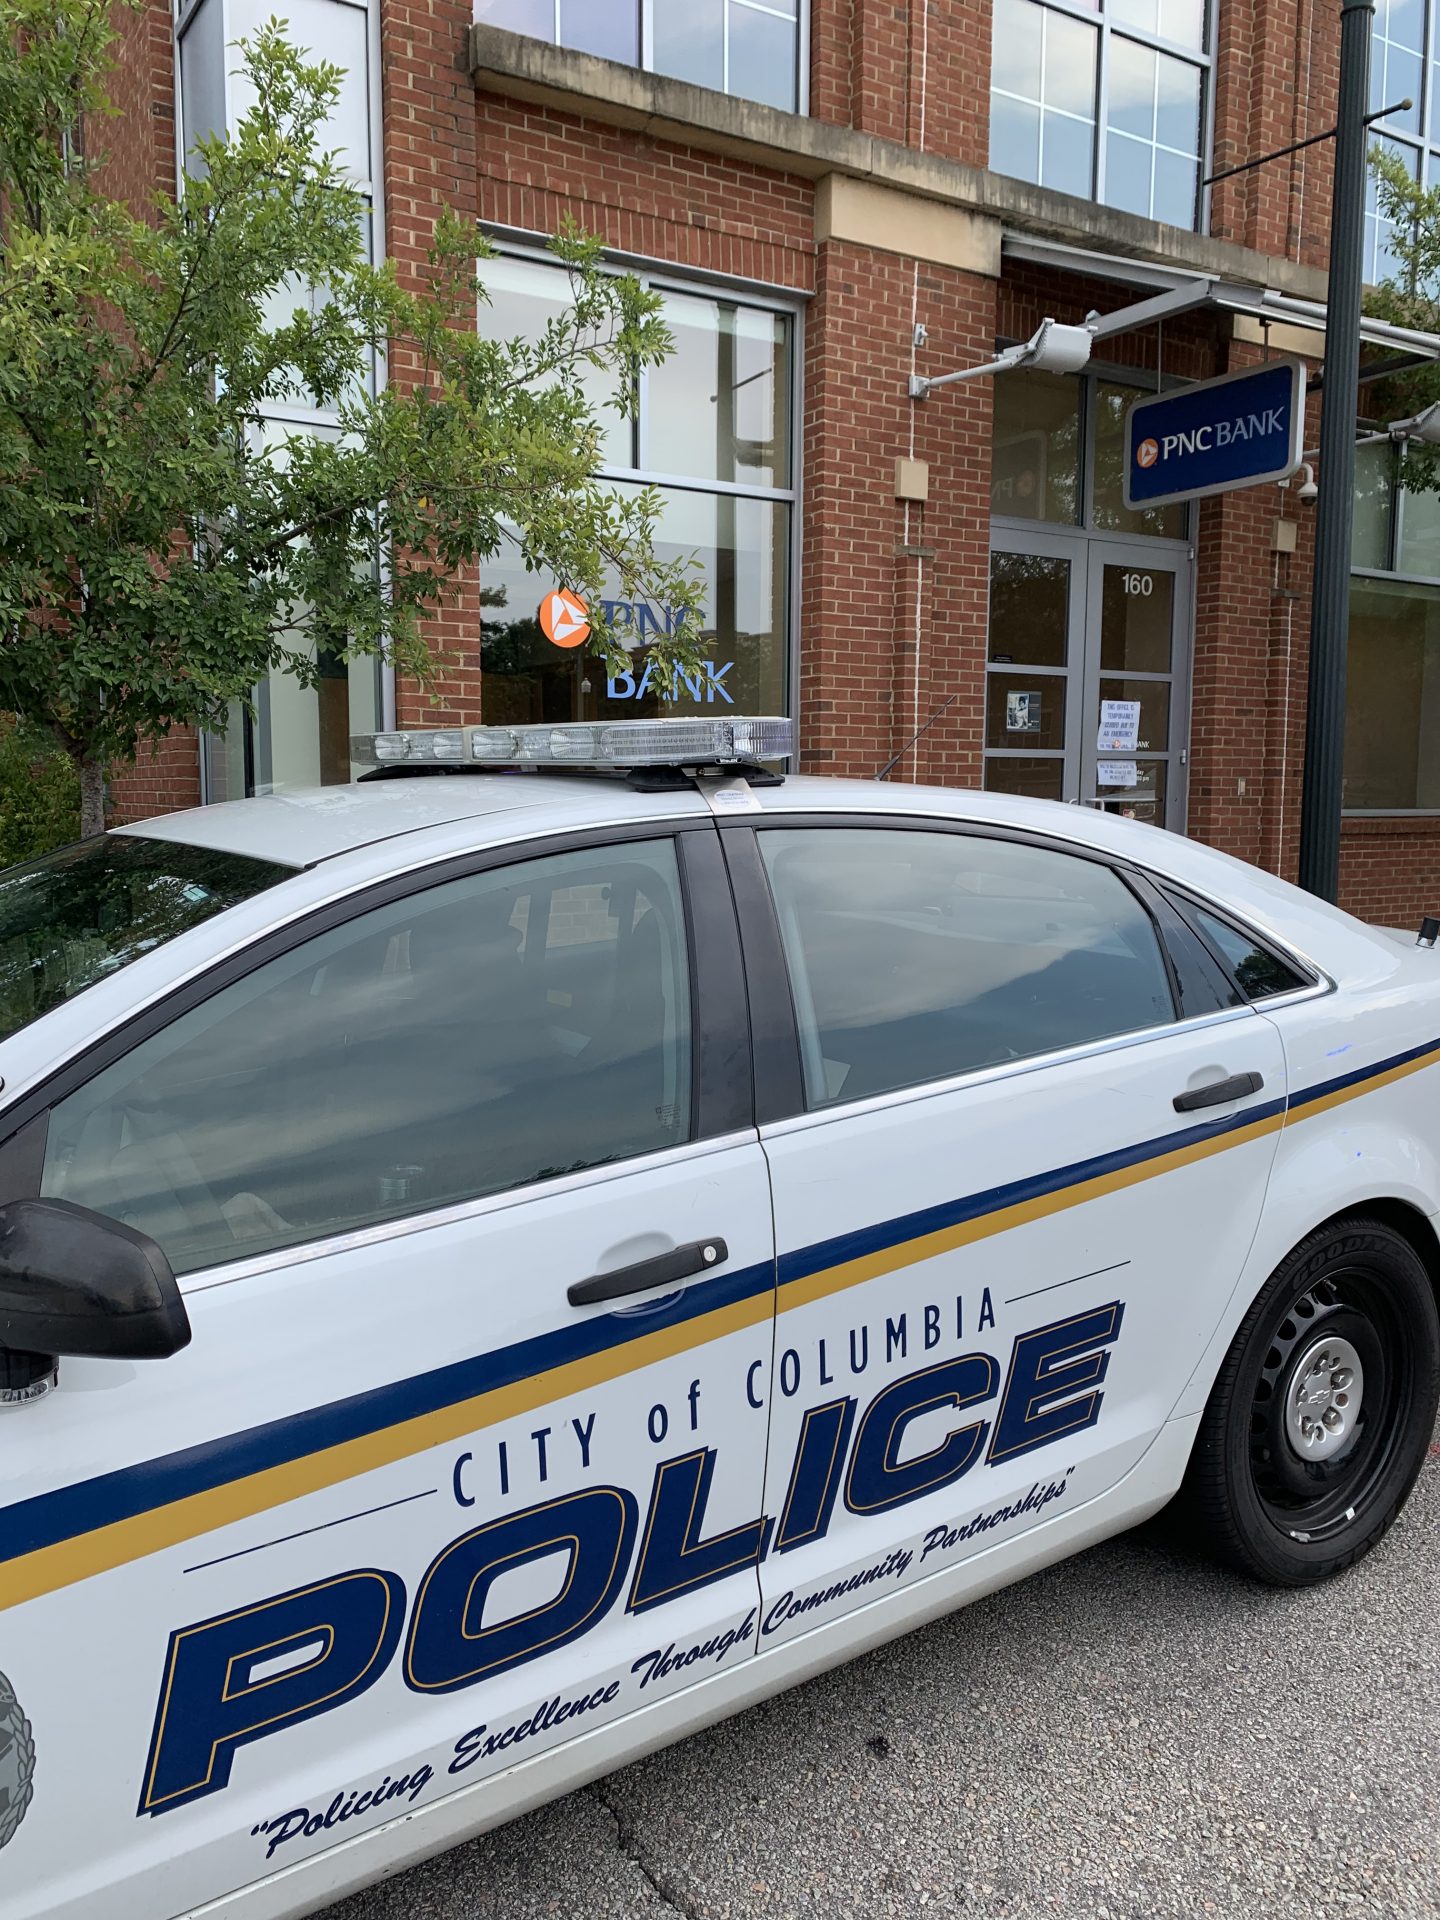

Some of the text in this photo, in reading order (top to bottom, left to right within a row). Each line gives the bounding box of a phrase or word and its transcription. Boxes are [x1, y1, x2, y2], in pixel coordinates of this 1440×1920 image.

[1161, 406, 1285, 460] PNC BANK
[1122, 573, 1153, 596] 160
[599, 653, 736, 704] BANK
[453, 1286, 996, 1508] CITY of COLUMBIA
[136, 1299, 1126, 1818] POLICE
[447, 1680, 620, 1774] Excellence
[630, 1607, 757, 1690] Through
[761, 1547, 914, 1636] Community
